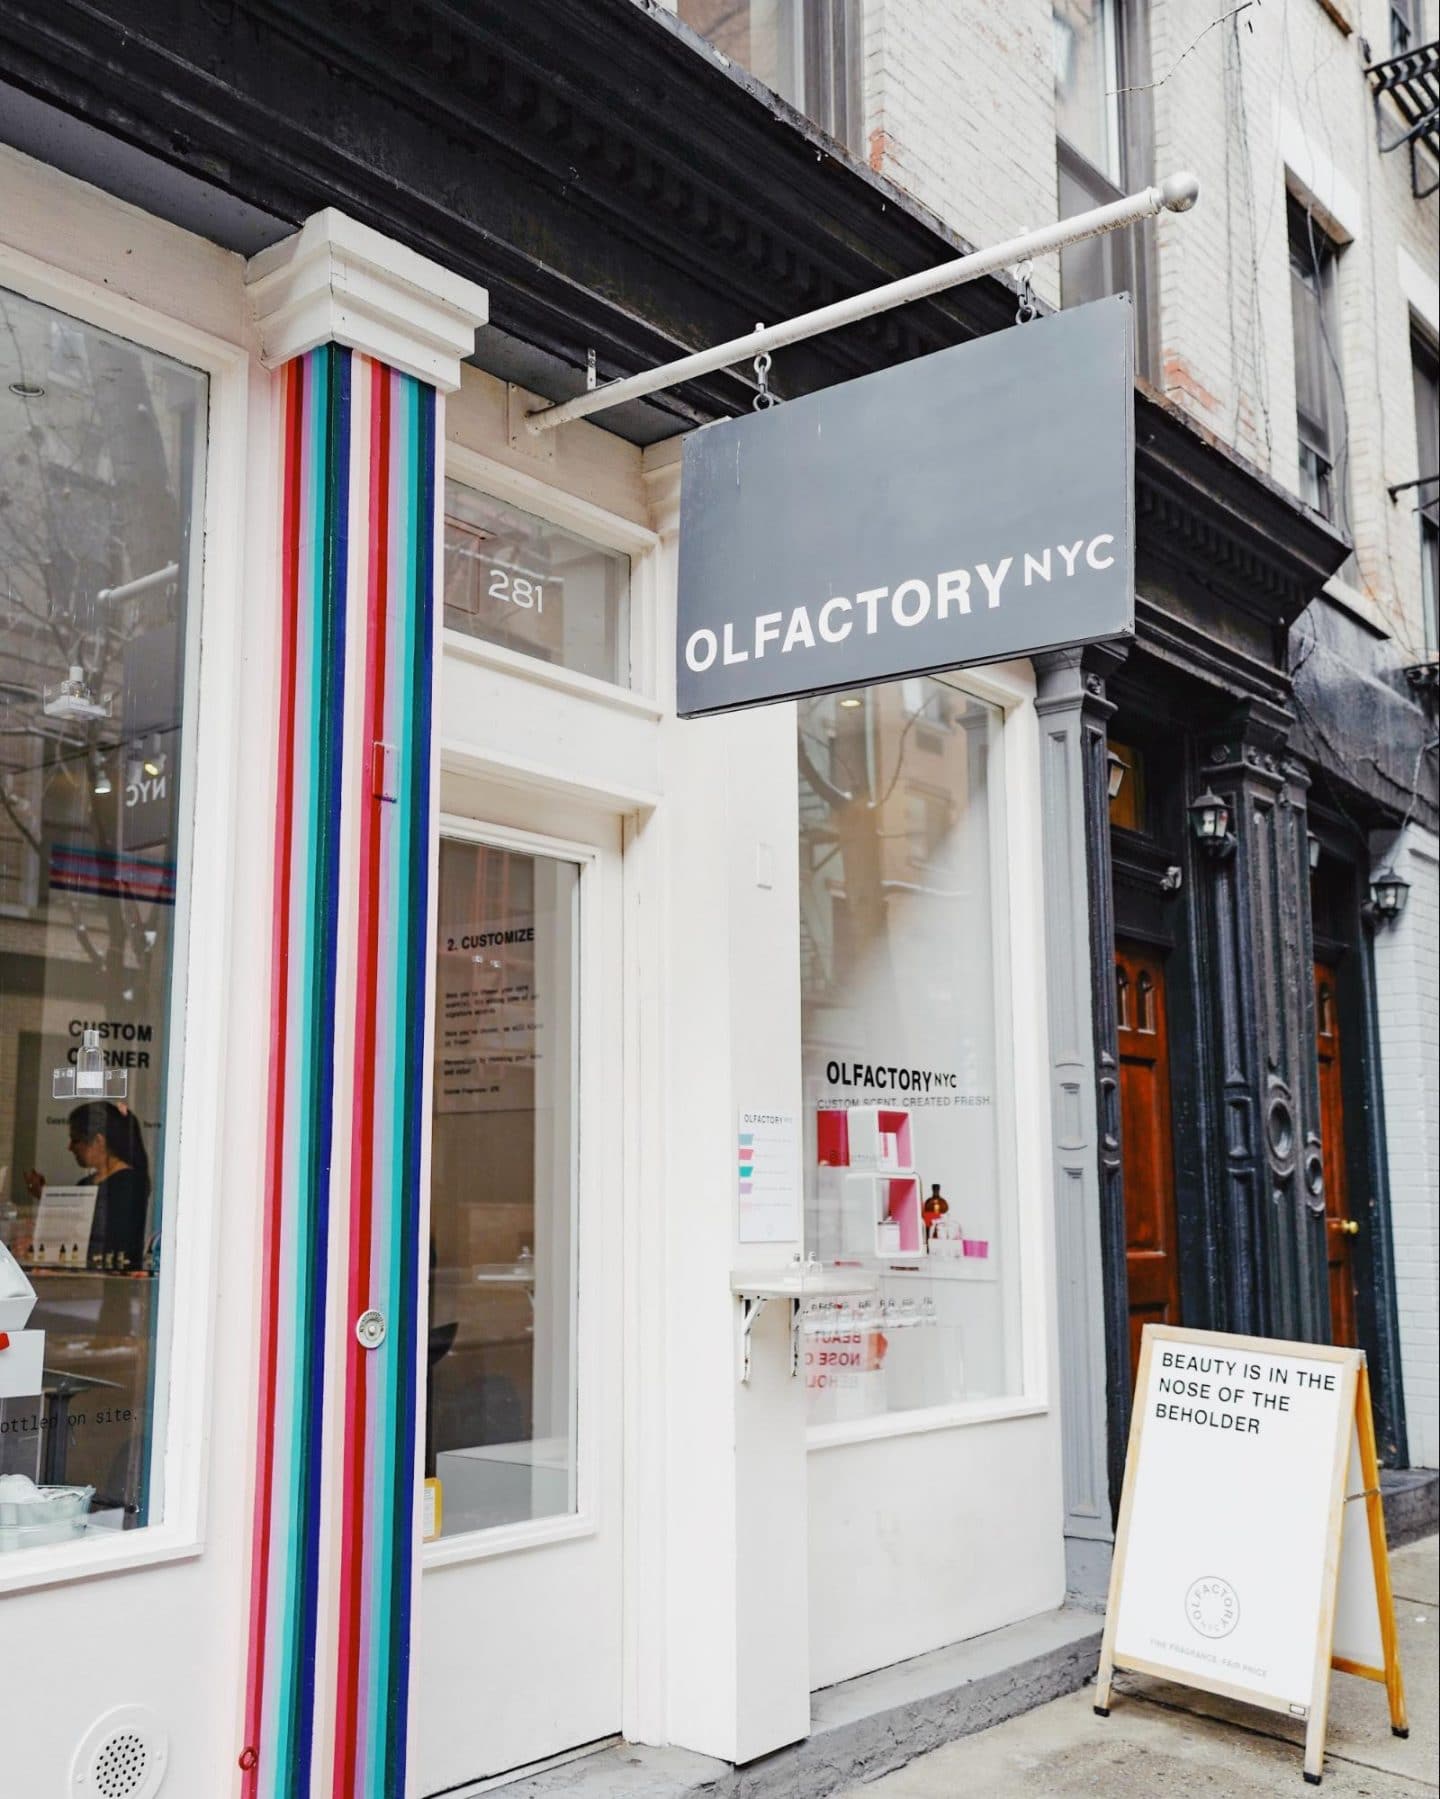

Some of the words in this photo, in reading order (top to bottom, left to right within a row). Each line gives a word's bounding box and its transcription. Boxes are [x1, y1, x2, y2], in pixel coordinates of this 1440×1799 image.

[489, 569, 543, 613] 281
[685, 557, 1013, 672] OLFACTORY
[1024, 534, 1115, 586] NYC
[447, 938, 458, 951] 2.
[461, 928, 535, 949] CUSTOMIZE
[67, 1048, 150, 1069] CRNER
[827, 1061, 932, 1092] OLFACTORY
[934, 1073, 958, 1089] NYC
[902, 1096, 951, 1107] CREATED
[1162, 1352, 1236, 1376] BEAUTY
[1243, 1363, 1262, 1380] IS
[1268, 1367, 1288, 1384] IN
[1296, 1371, 1336, 1391] THE
[1159, 1378, 1211, 1399] NOSE
[1218, 1386, 1245, 1403] OF
[1252, 1391, 1290, 1412] THE
[0, 1411, 58, 1433] ottled
[67, 1412, 86, 1426] on
[96, 1408, 137, 1424] site.
[1155, 1403, 1260, 1434] BEHOLDER
